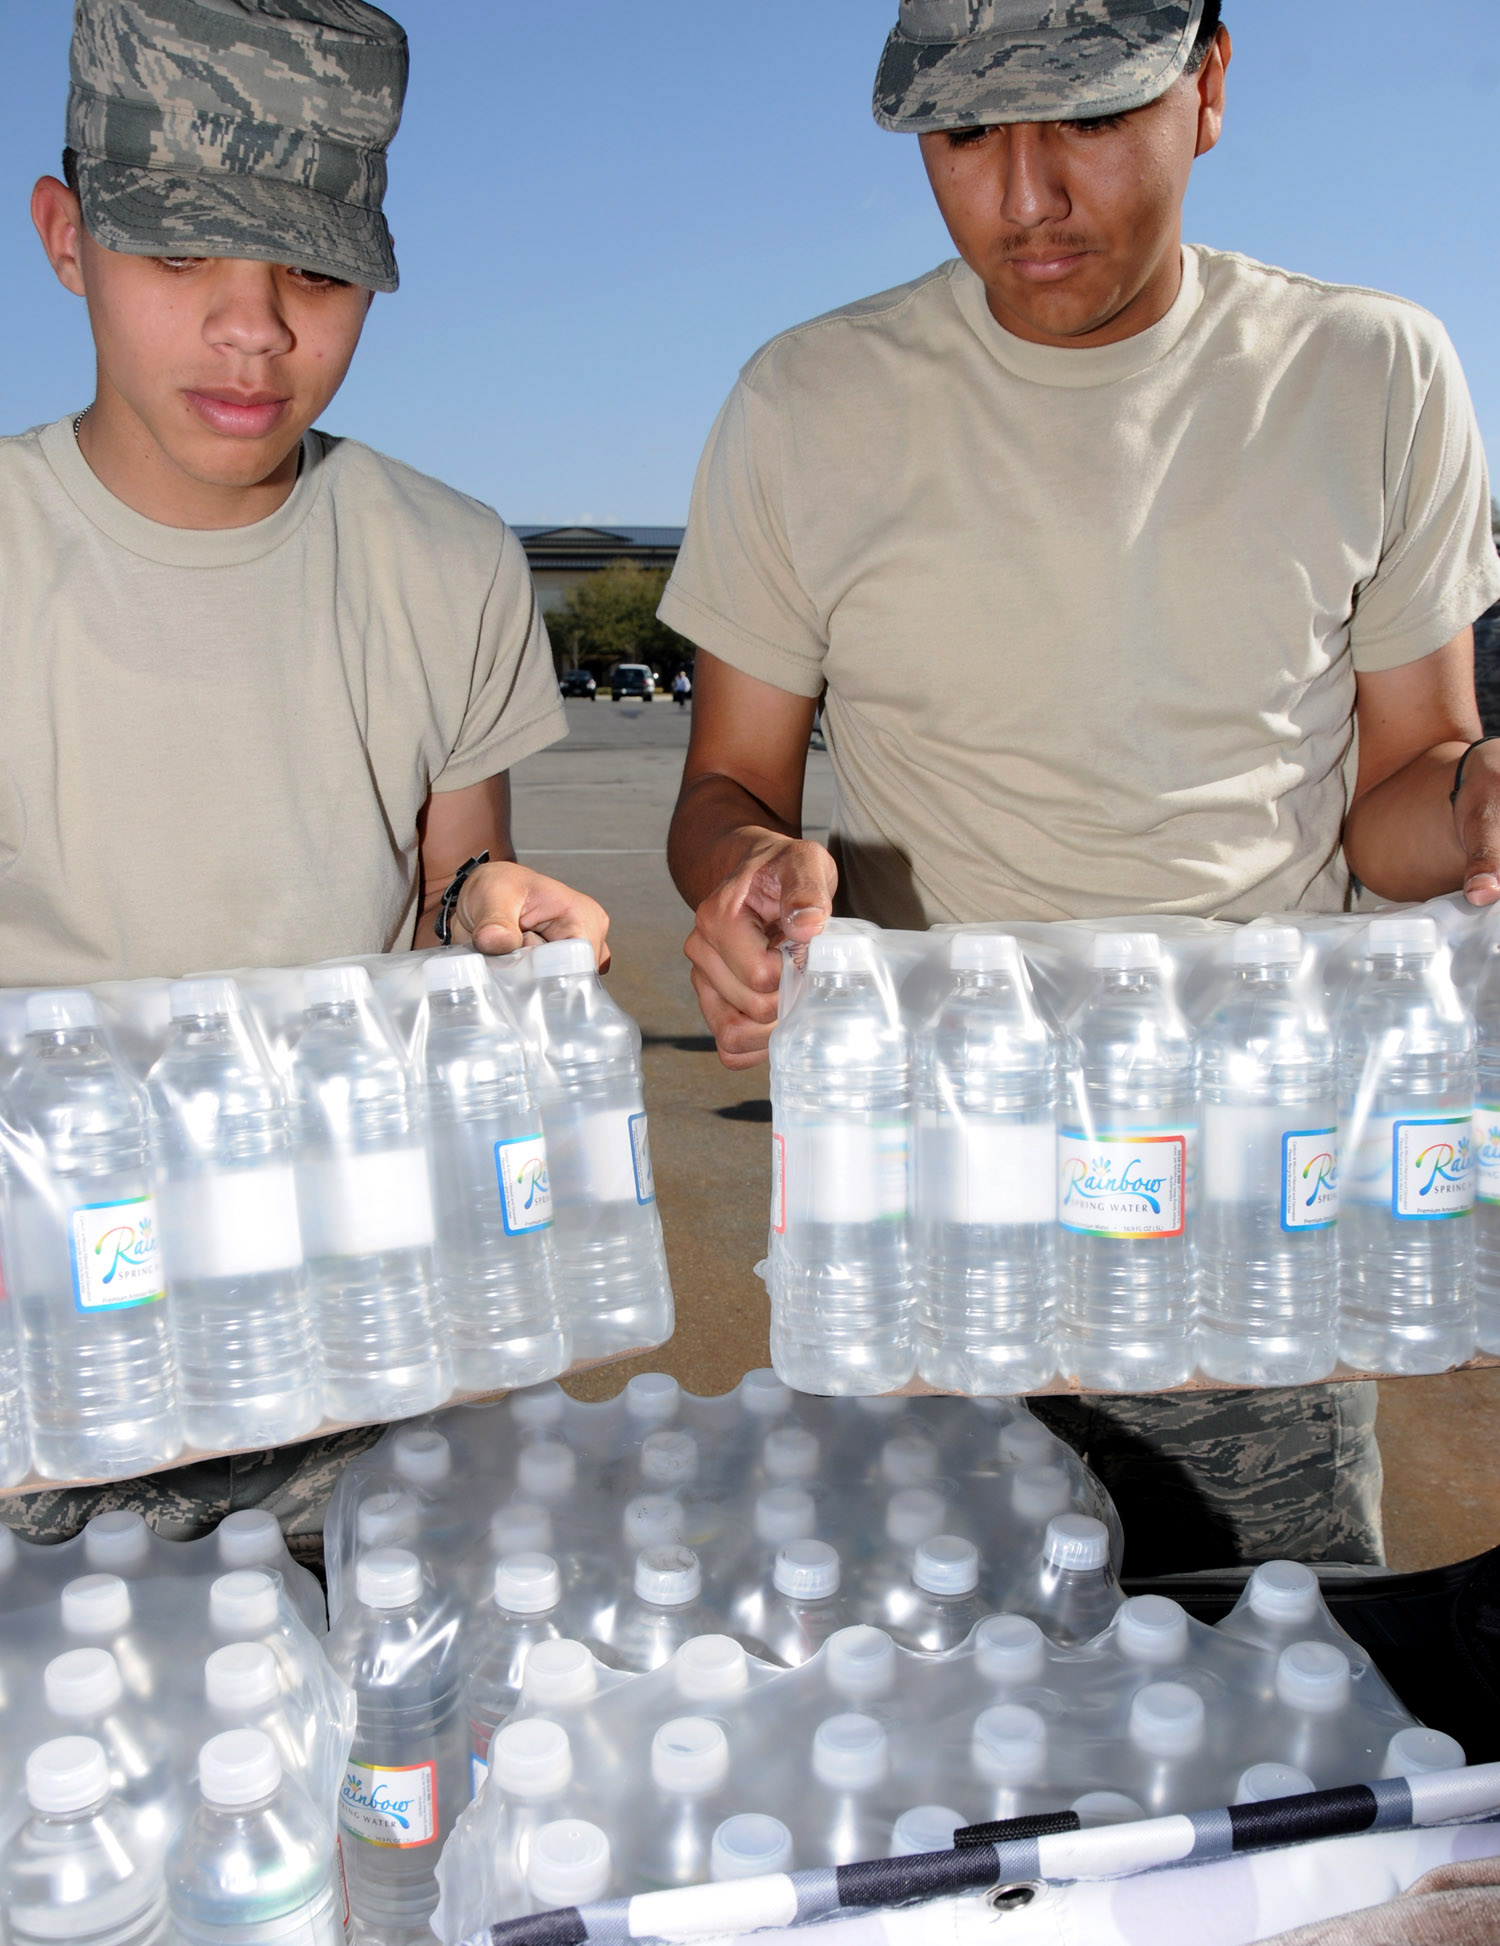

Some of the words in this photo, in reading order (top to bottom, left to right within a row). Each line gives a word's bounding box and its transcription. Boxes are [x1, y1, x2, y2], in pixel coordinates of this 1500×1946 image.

[1062, 1157, 1167, 1214] Rainbow
[1434, 1183, 1467, 1194] SPRING
[1071, 1199, 1105, 1211] SPRING
[1110, 1203, 1148, 1213] WATER
[118, 1264, 153, 1281] SPRING
[341, 1783, 415, 1822] ainbow
[340, 1802, 360, 1820] RING
[363, 1815, 397, 1828] WATER
